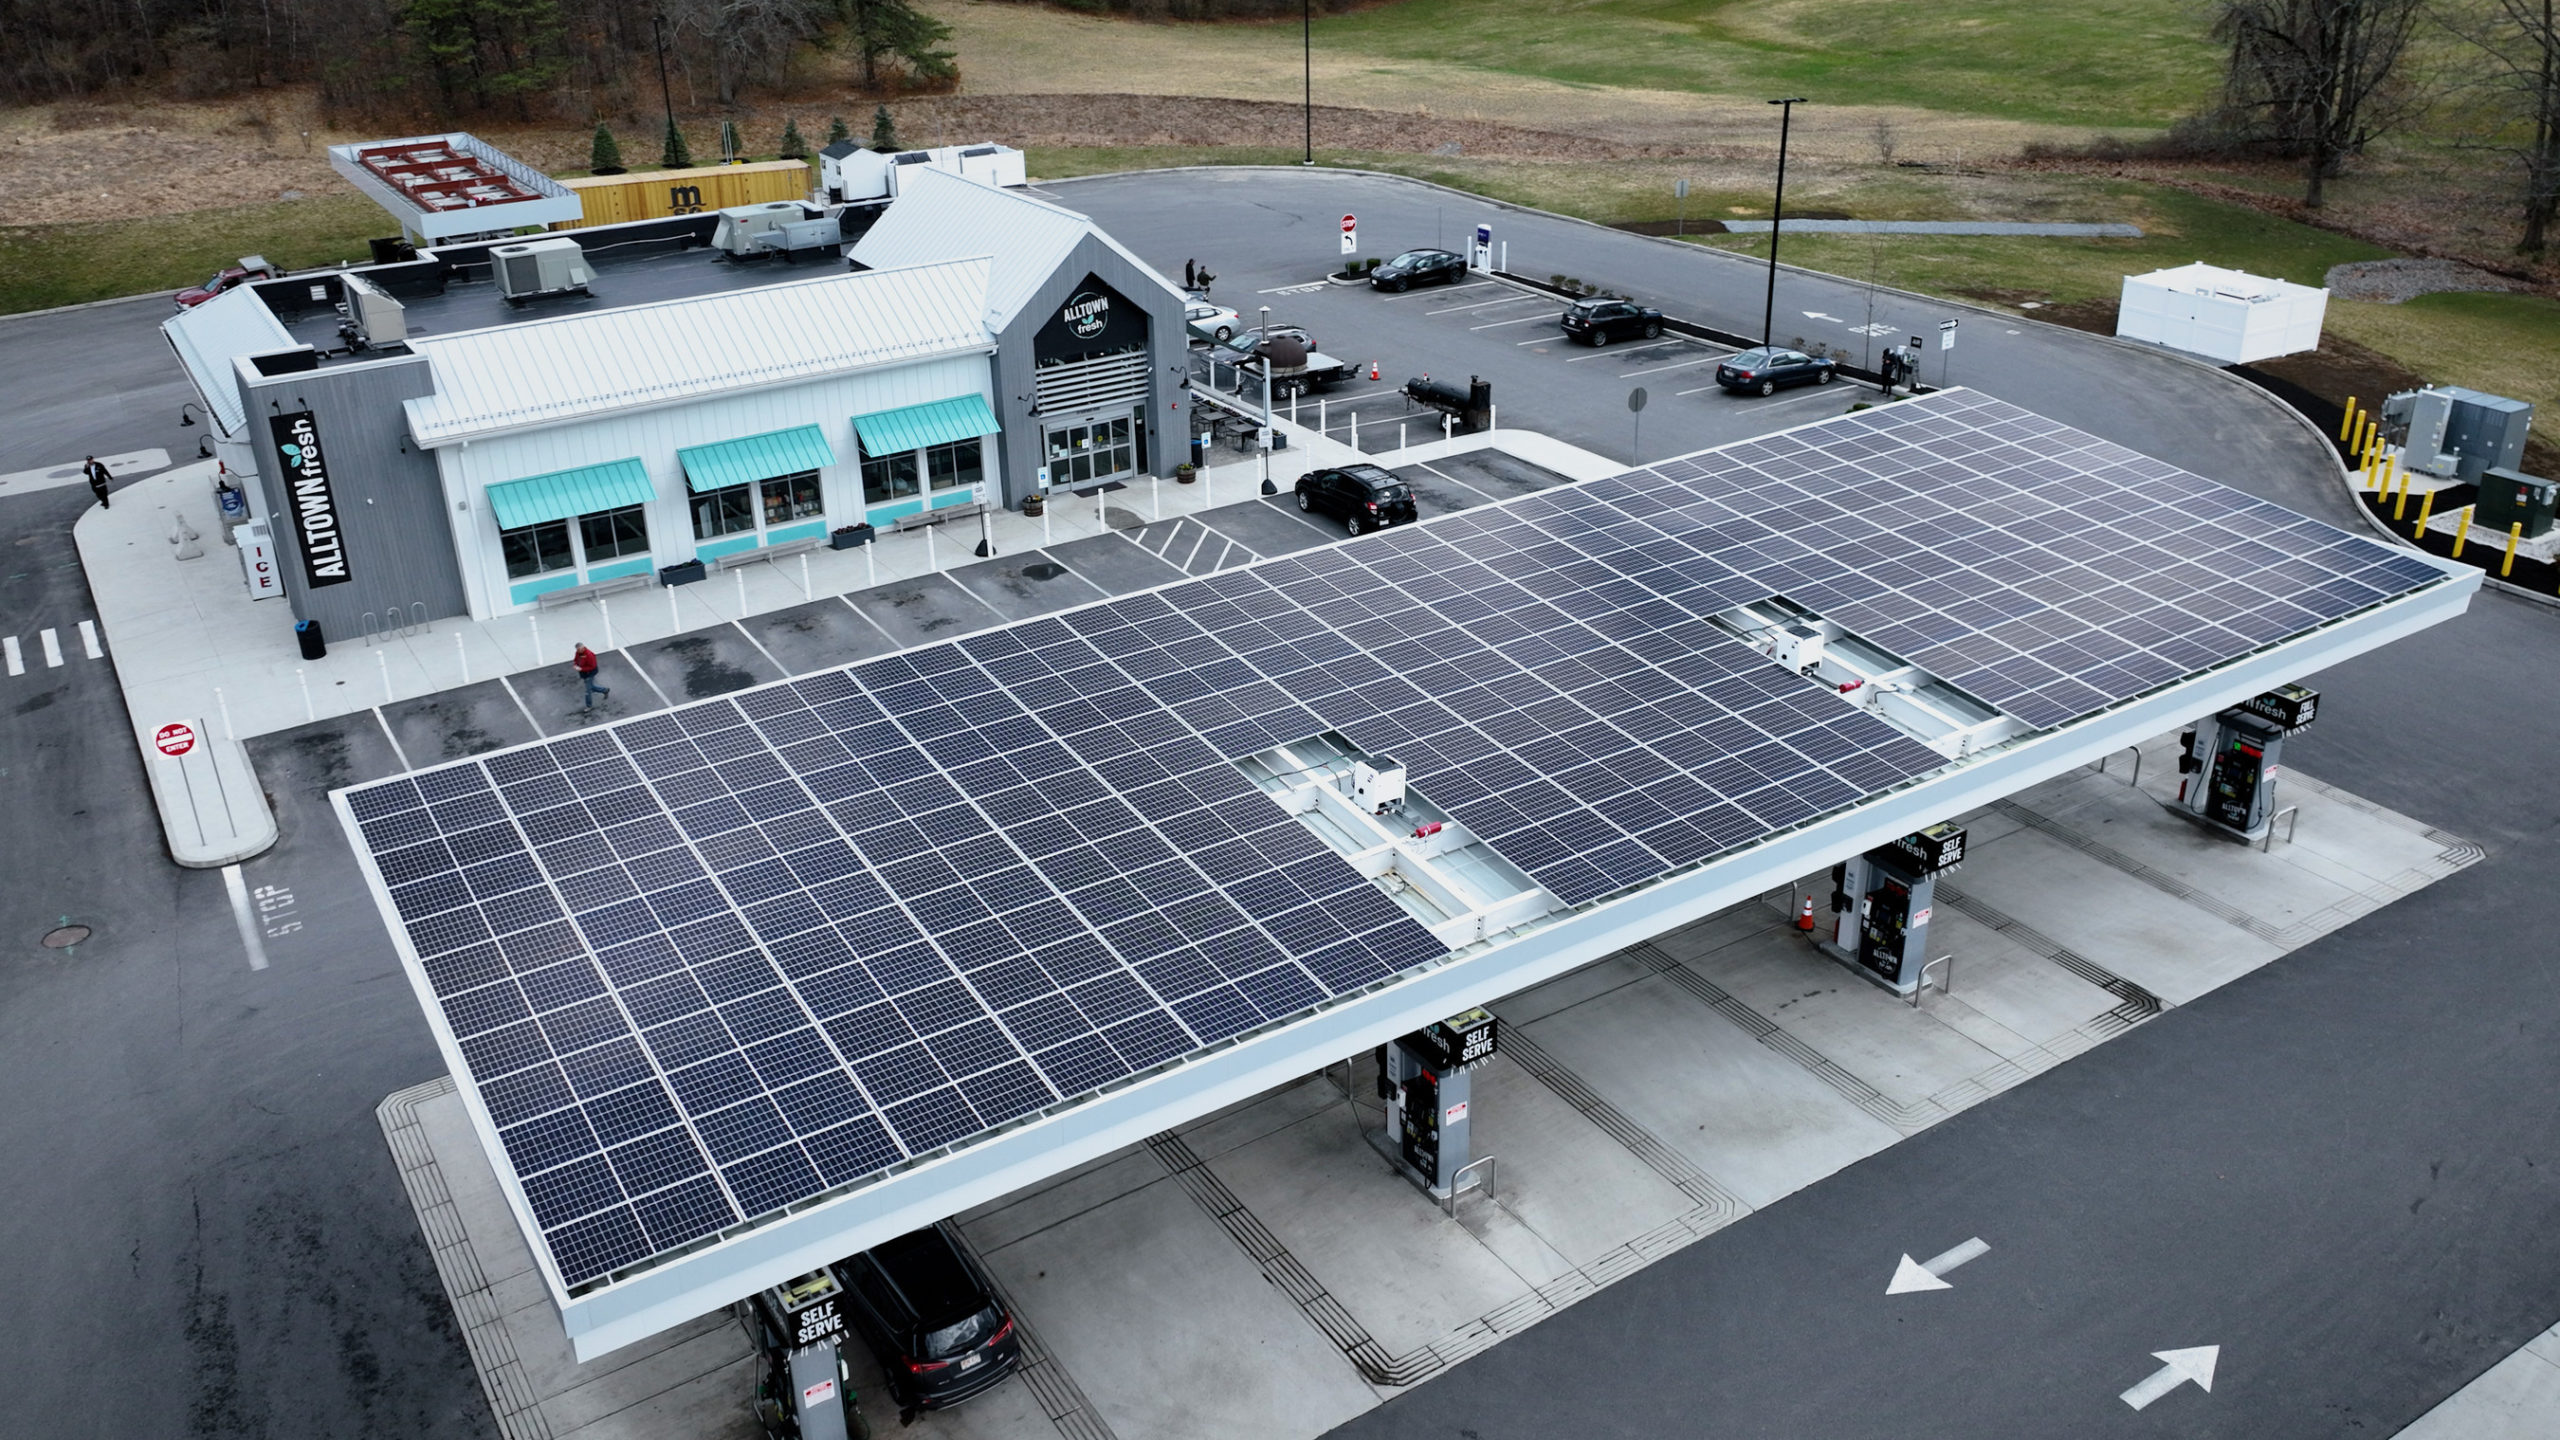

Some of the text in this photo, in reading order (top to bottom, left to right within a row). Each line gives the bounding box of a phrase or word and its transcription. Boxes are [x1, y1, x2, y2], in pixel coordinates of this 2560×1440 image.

[1064, 297, 1109, 322] ALLTOWN
[1078, 320, 1103, 334] fresh
[291, 419, 346, 577] ALLTOWN fresh
[255, 546, 272, 589] ICE
[2255, 699, 2287, 720] fresh
[2295, 708, 2316, 725] SERVE
[2300, 699, 2315, 713] FULL
[158, 727, 187, 739] DO NOT
[165, 742, 190, 752] ENTER
[1942, 836, 1962, 854] SELF
[1937, 847, 1963, 867] SERVE
[253, 885, 304, 938] STOP
[1465, 1026, 1490, 1047] SELF
[1462, 1038, 1493, 1061] SERVE
[801, 1301, 834, 1327] SELF
[798, 1313, 843, 1343] SERVE
